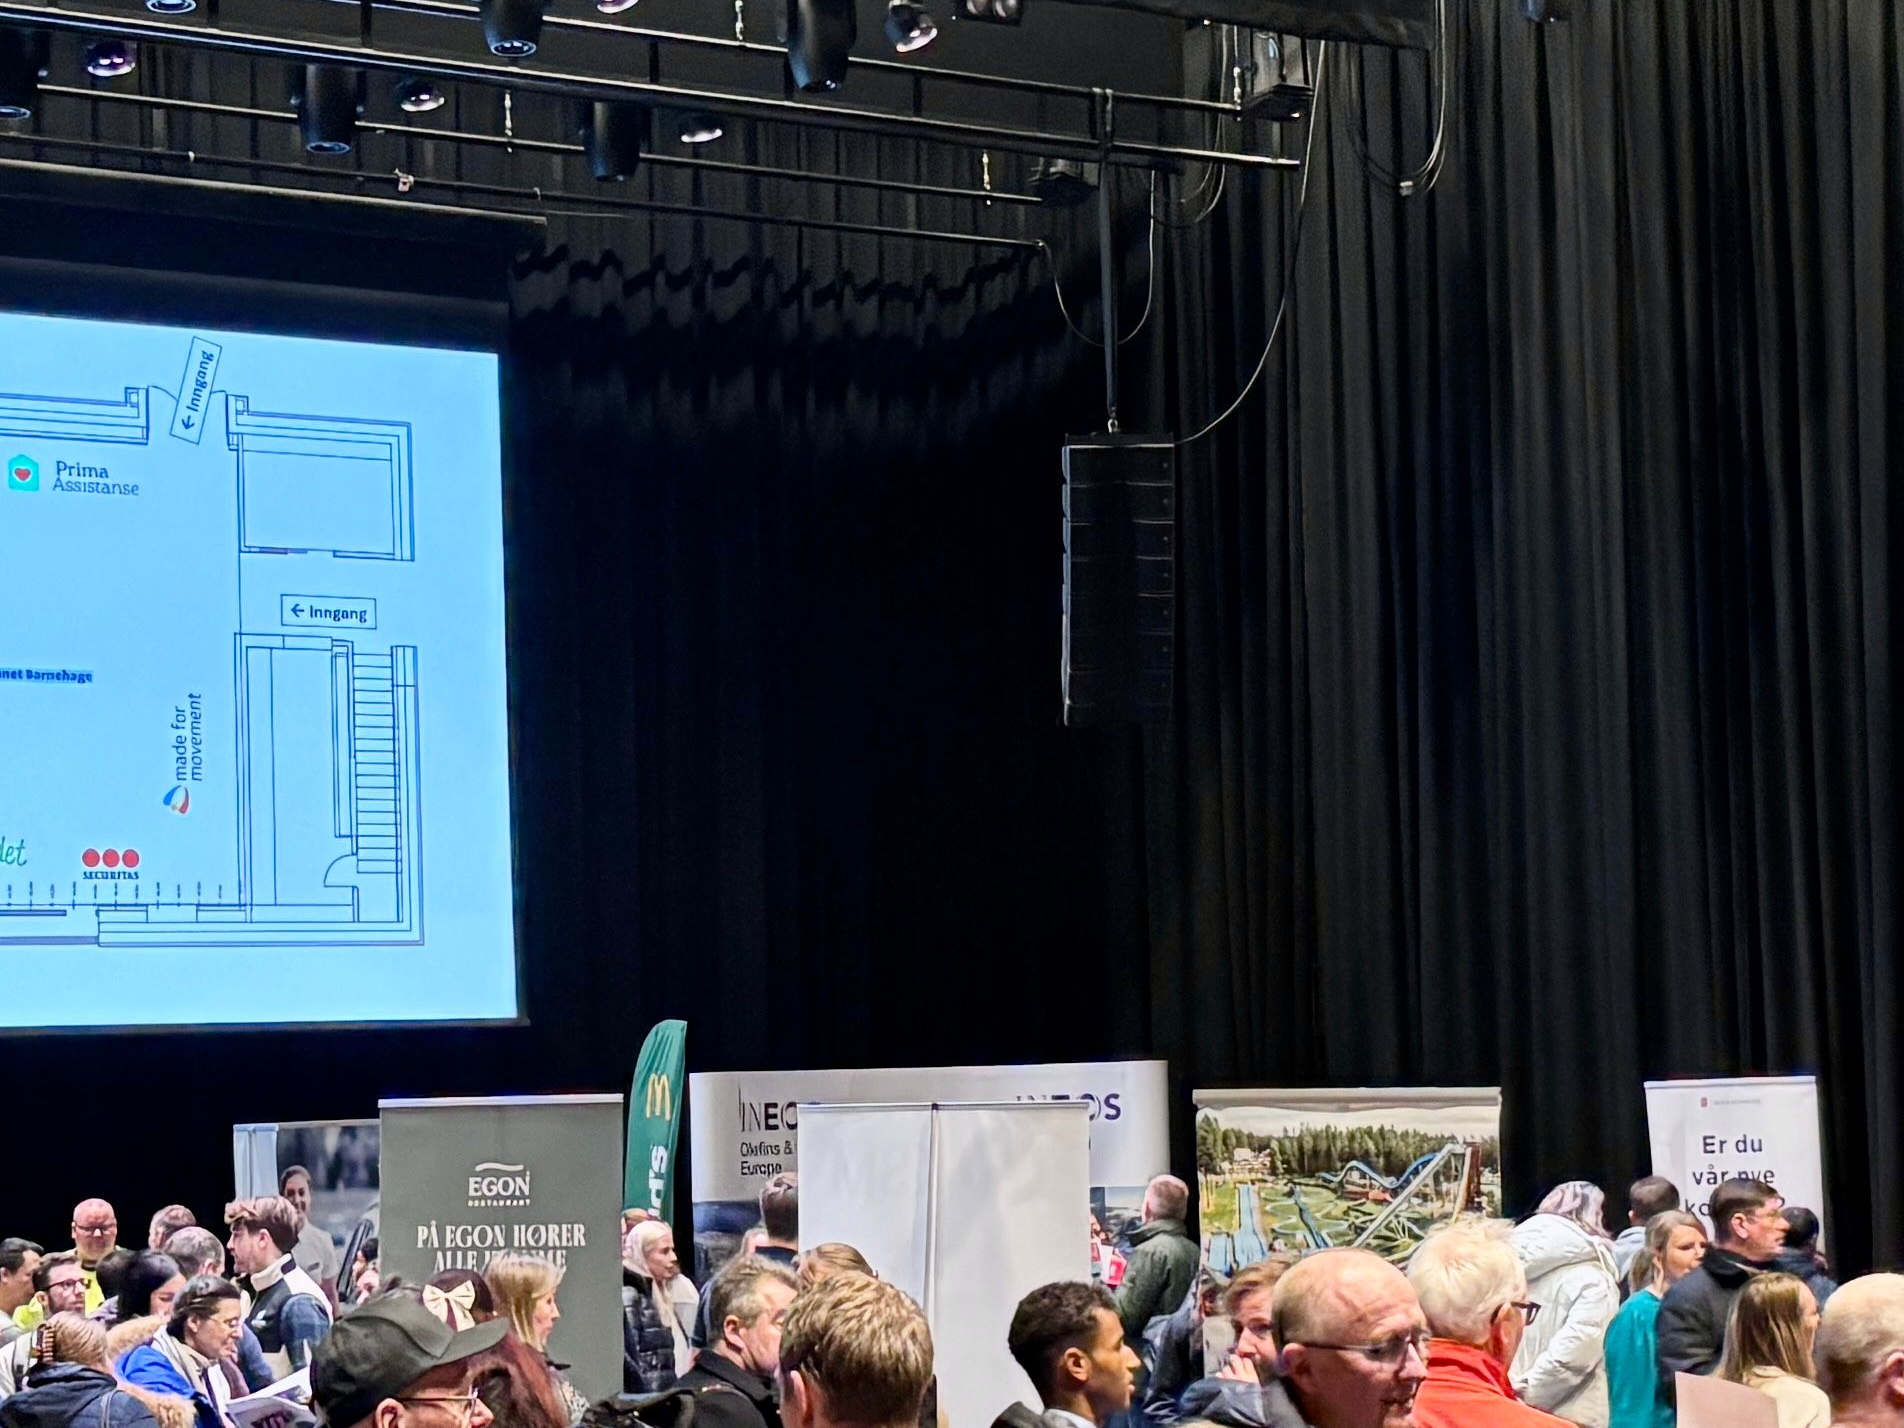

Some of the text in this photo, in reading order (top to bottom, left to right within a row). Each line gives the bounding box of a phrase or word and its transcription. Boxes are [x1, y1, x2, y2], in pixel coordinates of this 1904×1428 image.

[189, 350, 215, 413] Inngang
[56, 460, 109, 479] Prima
[53, 477, 140, 496] Assistanse
[309, 604, 367, 624] Inngang
[171, 705, 188, 781] made for
[188, 692, 204, 782] movement
[82, 871, 140, 880] SECURITAS
[740, 1102, 798, 1132] INEO
[784, 1140, 793, 1155] &
[1702, 1133, 1764, 1154] Er du
[468, 1172, 530, 1197] EGON
[1692, 1164, 1729, 1186] vår
[416, 1220, 586, 1249] PÅ EGON HØRER
[434, 1249, 478, 1273] ALLE
